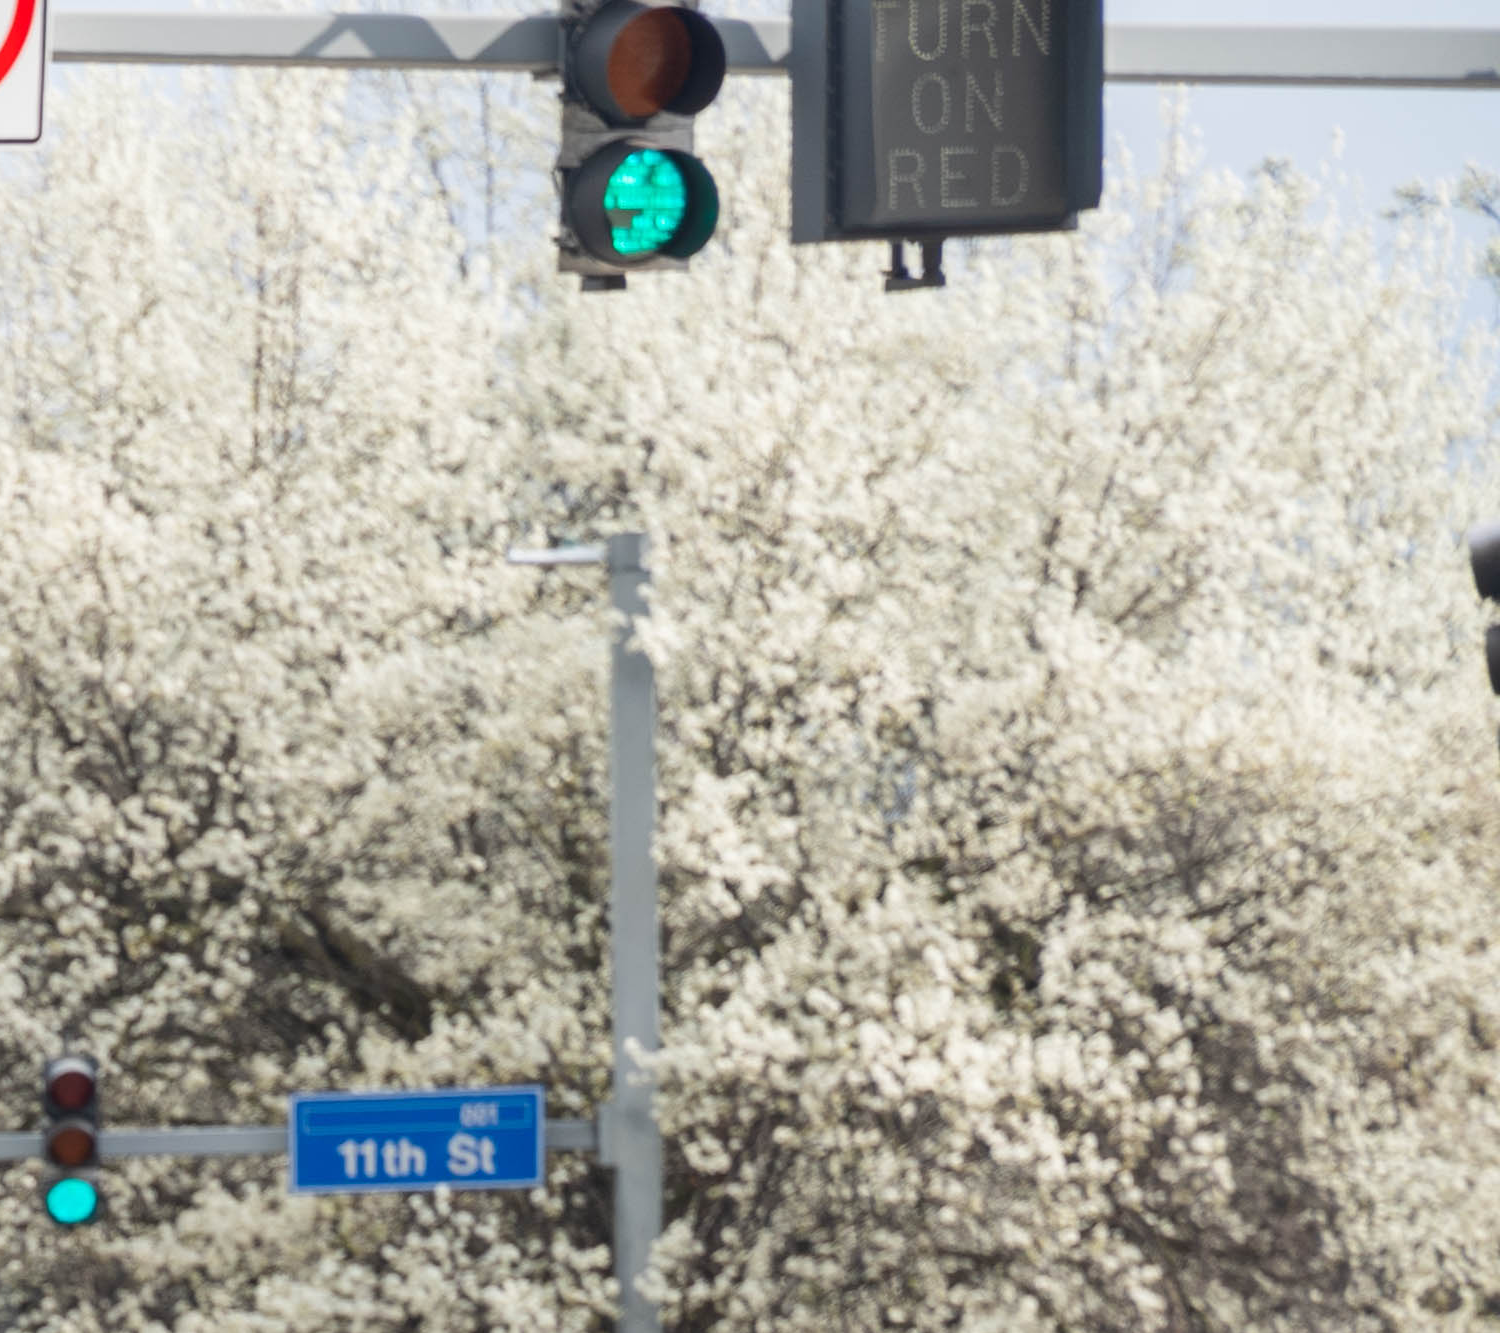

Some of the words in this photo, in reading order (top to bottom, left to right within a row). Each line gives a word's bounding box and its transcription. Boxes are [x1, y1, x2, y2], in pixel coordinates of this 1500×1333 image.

[873, 0, 1051, 61] TURN
[911, 71, 1004, 135] ON
[888, 146, 1030, 210] RED
[337, 1137, 427, 1179] 11th
[447, 1132, 497, 1177] St
